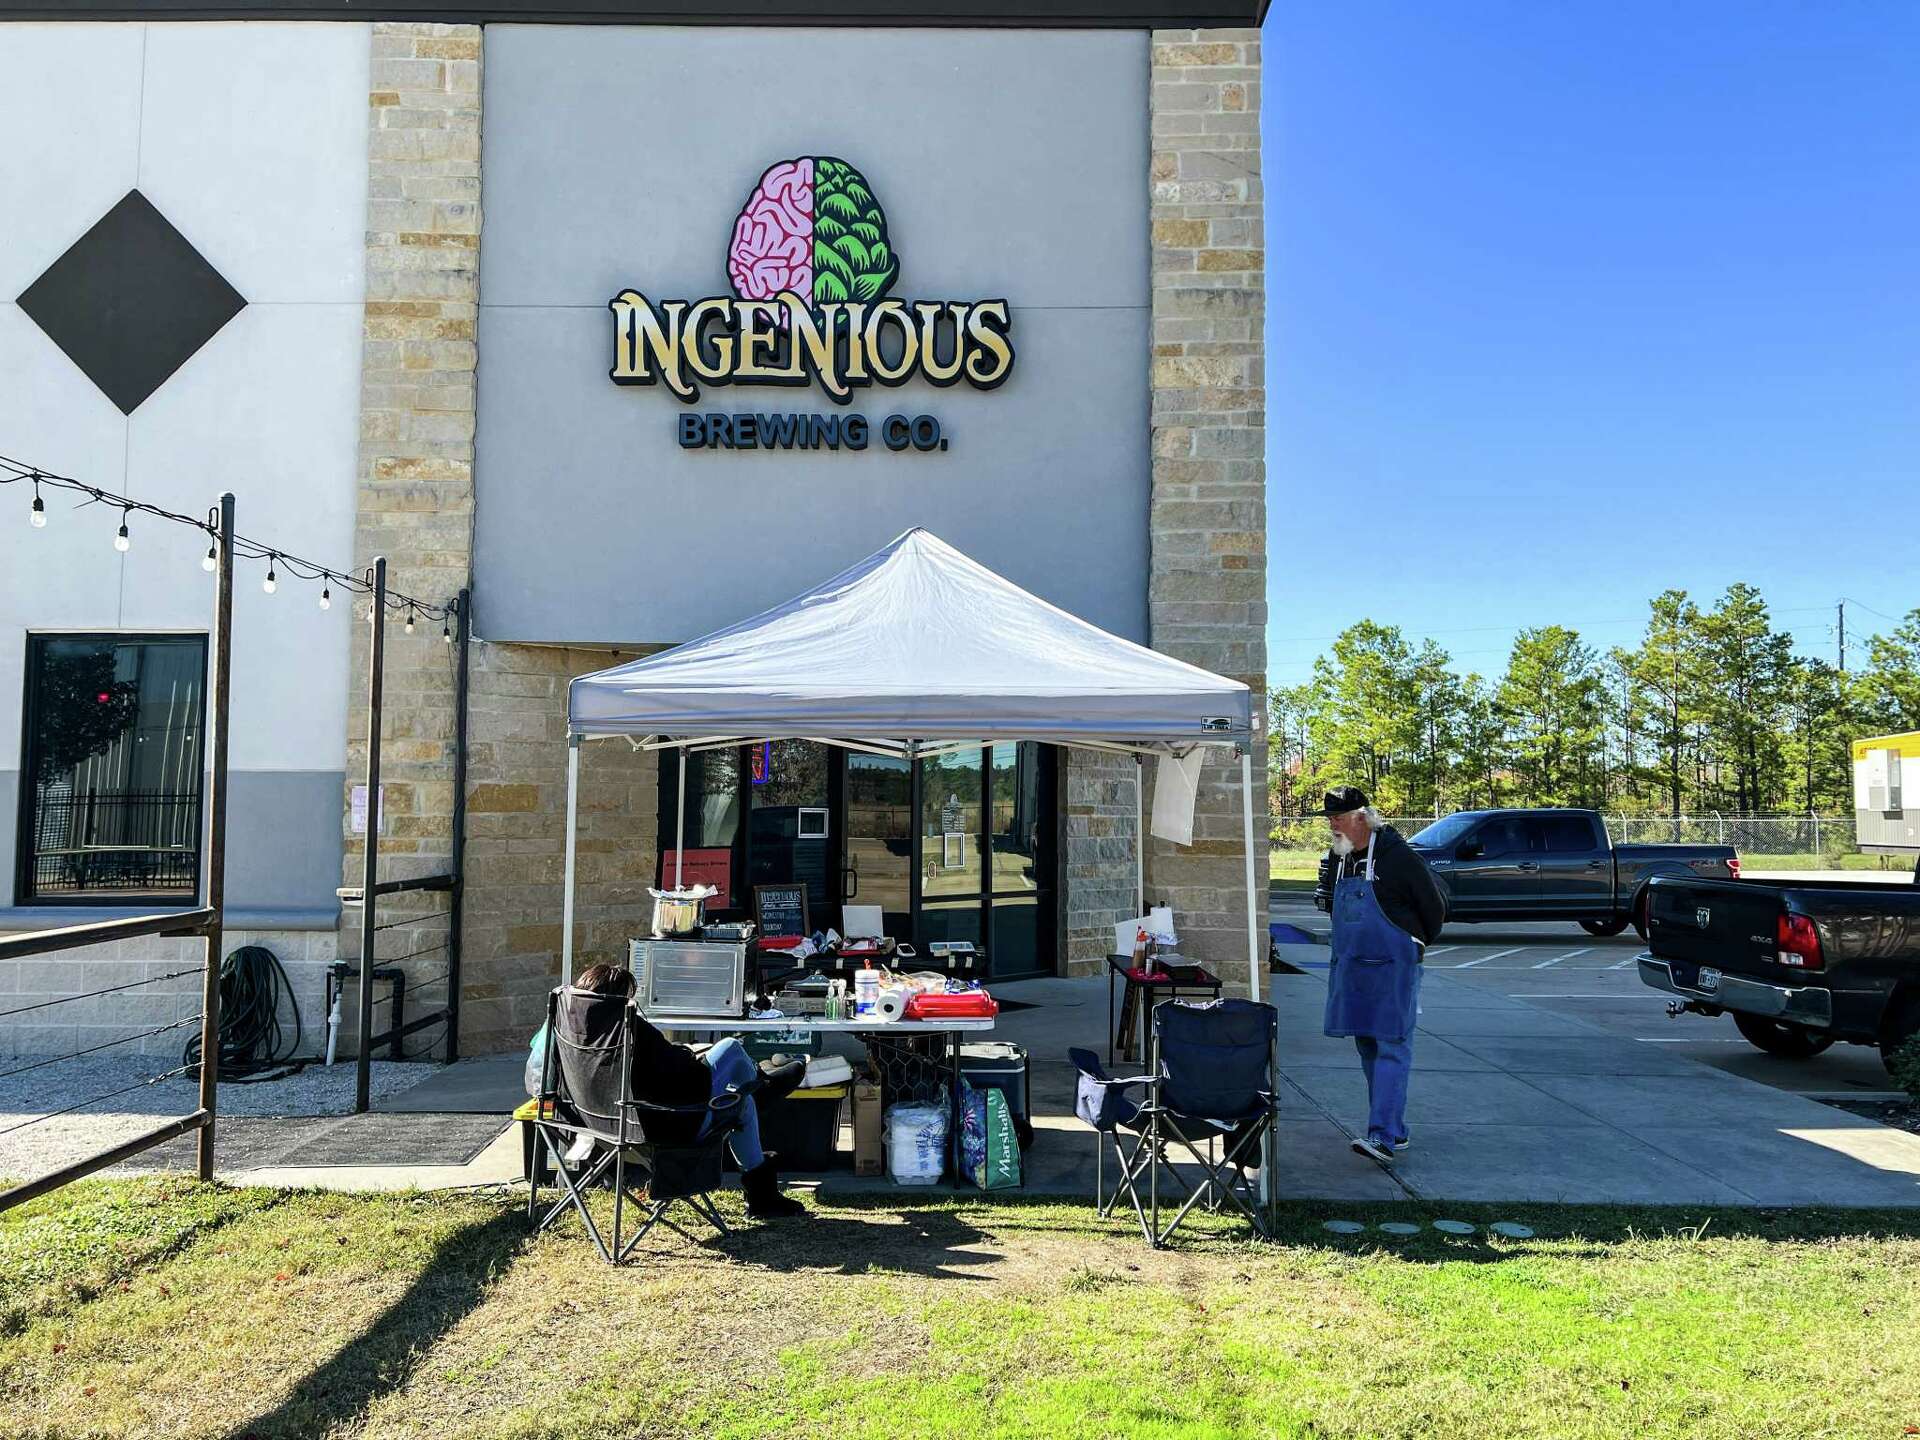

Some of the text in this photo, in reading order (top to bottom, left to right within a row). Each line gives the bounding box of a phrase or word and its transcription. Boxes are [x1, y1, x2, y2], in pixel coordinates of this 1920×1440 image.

[609, 289, 1016, 404] INGENIOUS
[678, 412, 949, 451] BREWING CO.
[998, 1102, 1012, 1179] Marshalls
